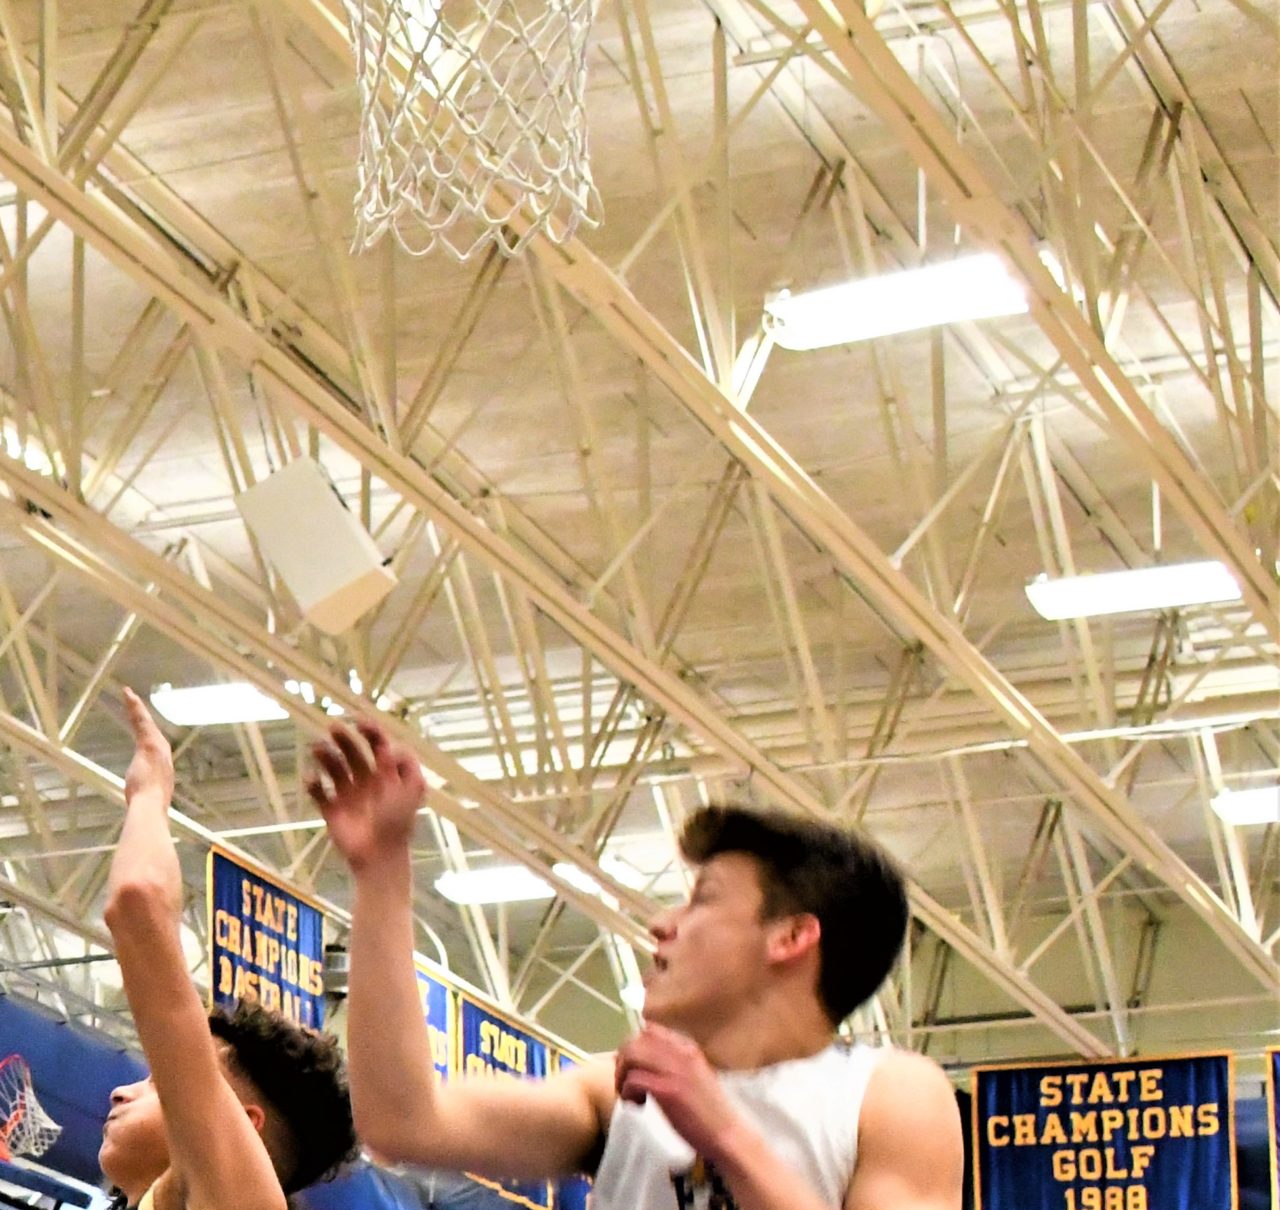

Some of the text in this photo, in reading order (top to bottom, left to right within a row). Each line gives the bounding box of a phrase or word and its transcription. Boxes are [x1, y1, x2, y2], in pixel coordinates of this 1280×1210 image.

[242, 879, 298, 942] STATE
[216, 909, 323, 996] CHAMPIONS
[1039, 1068, 1163, 1107] STATE
[986, 1103, 1219, 1147] CHAMPIONS
[1052, 1145, 1155, 1182] GOLF
